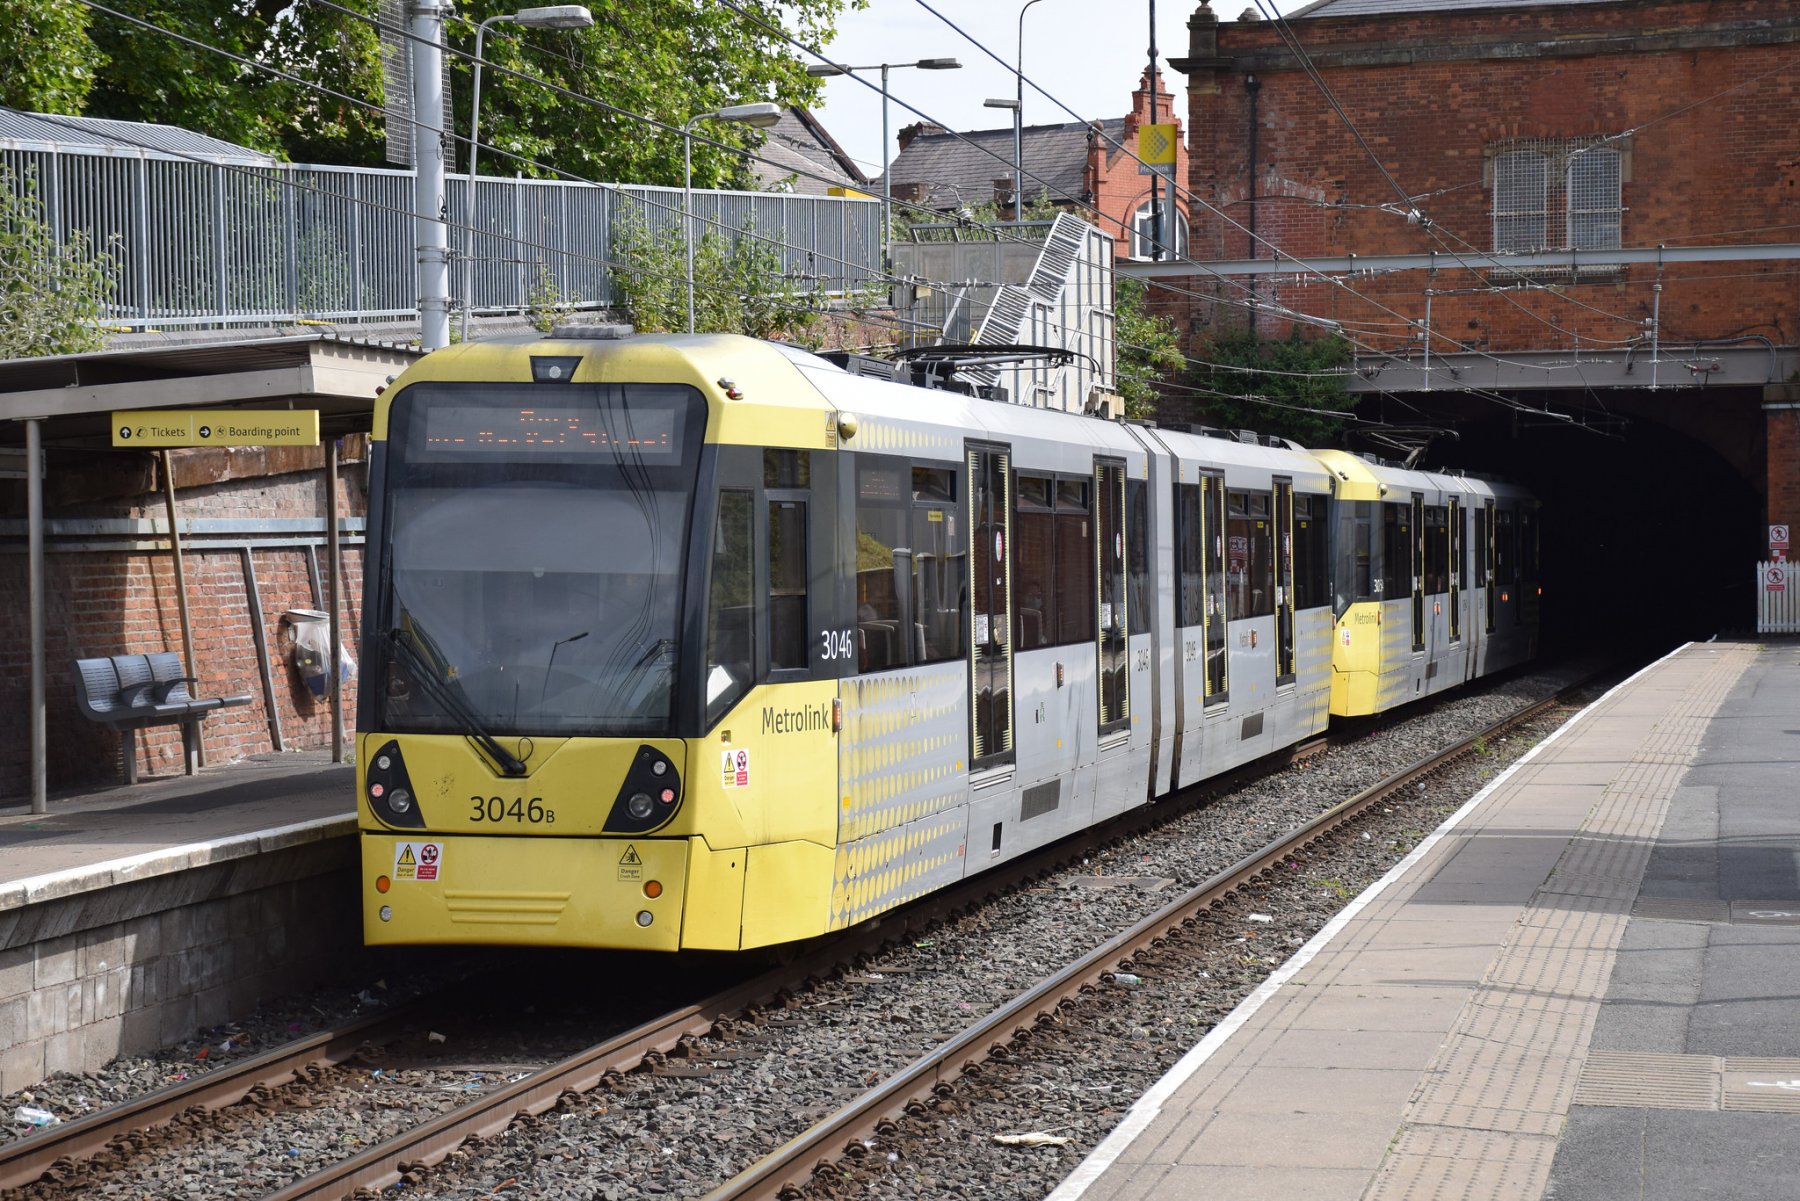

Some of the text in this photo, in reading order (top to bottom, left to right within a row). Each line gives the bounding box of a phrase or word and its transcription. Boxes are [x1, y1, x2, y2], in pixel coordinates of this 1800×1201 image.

[151, 427, 186, 437] Tickets
[229, 427, 301, 439] Boarding point
[821, 630, 852, 660] 3046
[762, 703, 829, 735] Metrolink
